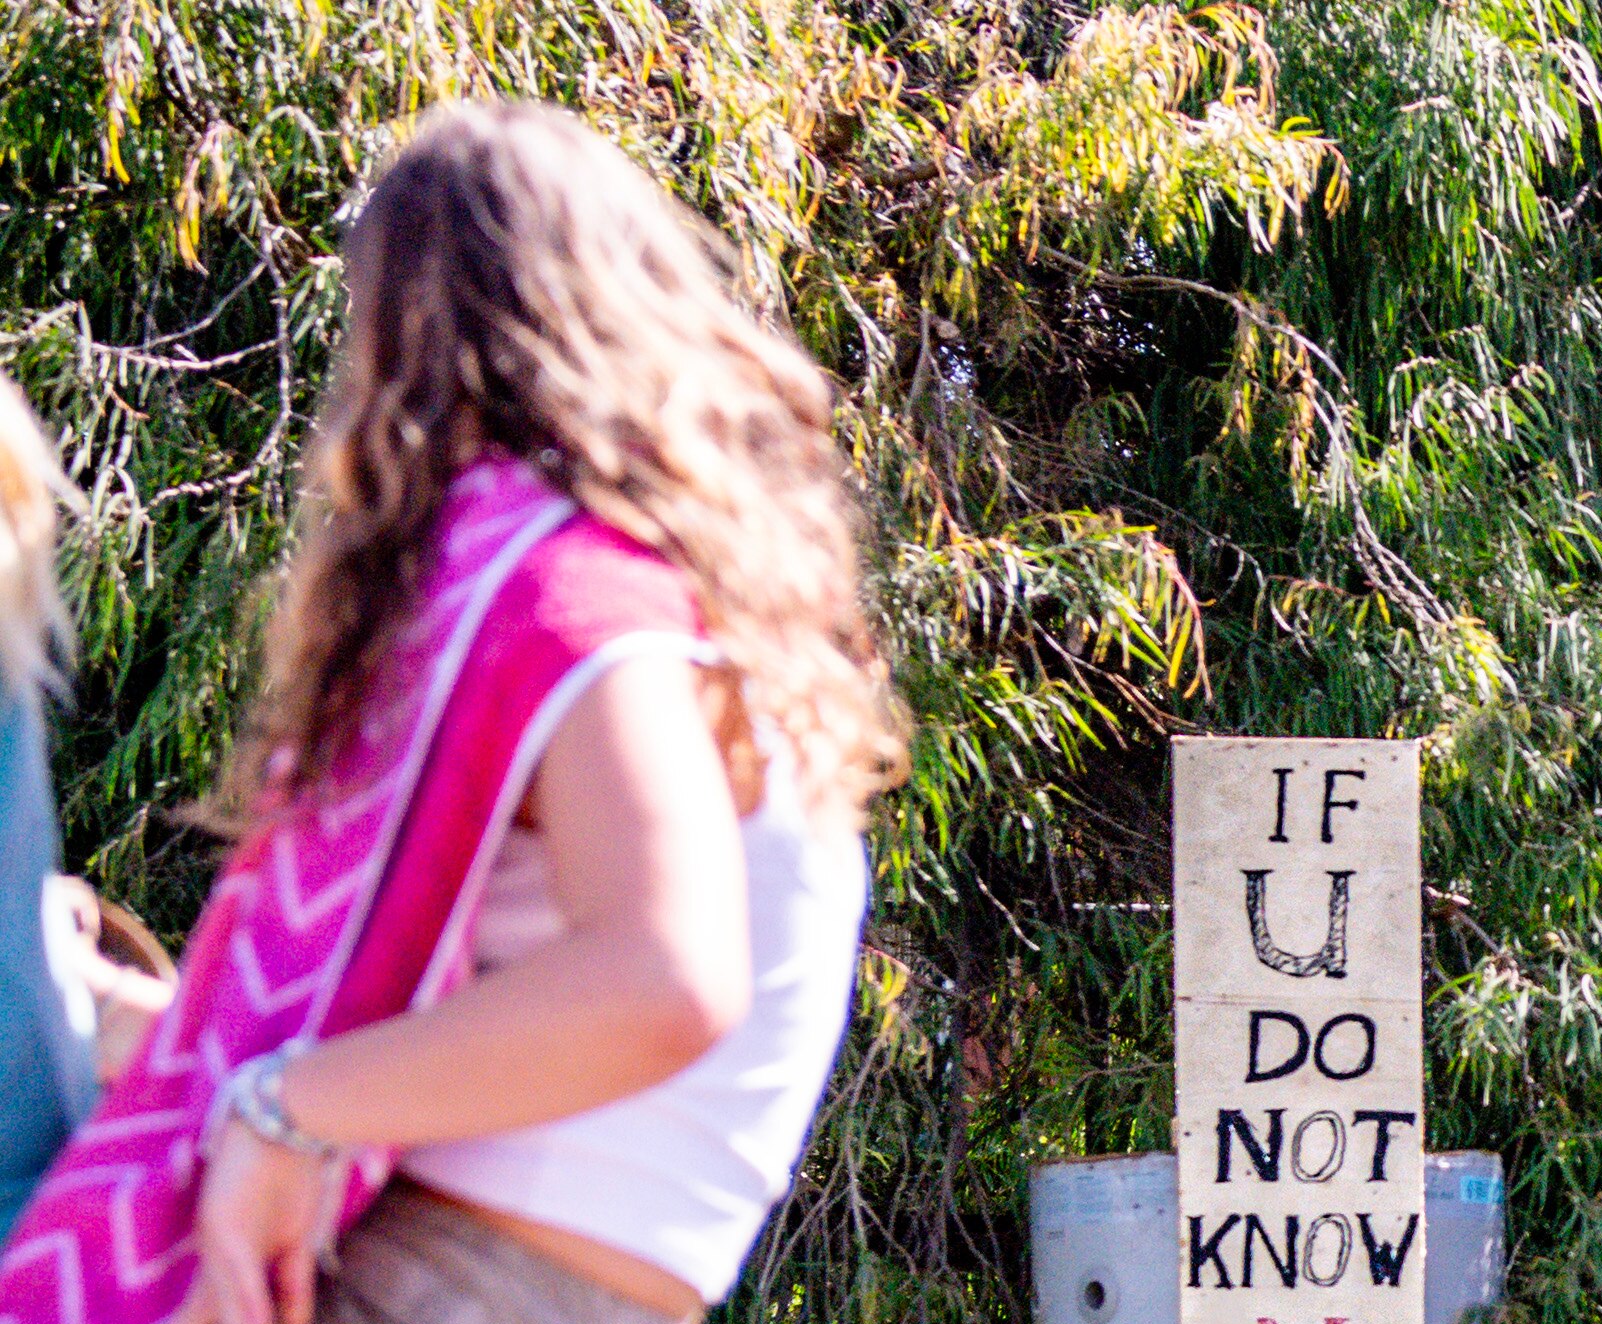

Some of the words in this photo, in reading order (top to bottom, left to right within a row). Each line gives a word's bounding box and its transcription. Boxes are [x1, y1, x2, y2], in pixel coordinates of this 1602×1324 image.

[1268, 768, 1366, 844] IF
[1240, 868, 1357, 979] U
[1245, 1010, 1376, 1083] DO
[1215, 1108, 1416, 1183] NOT
[1187, 1212, 1420, 1289] KNOW
